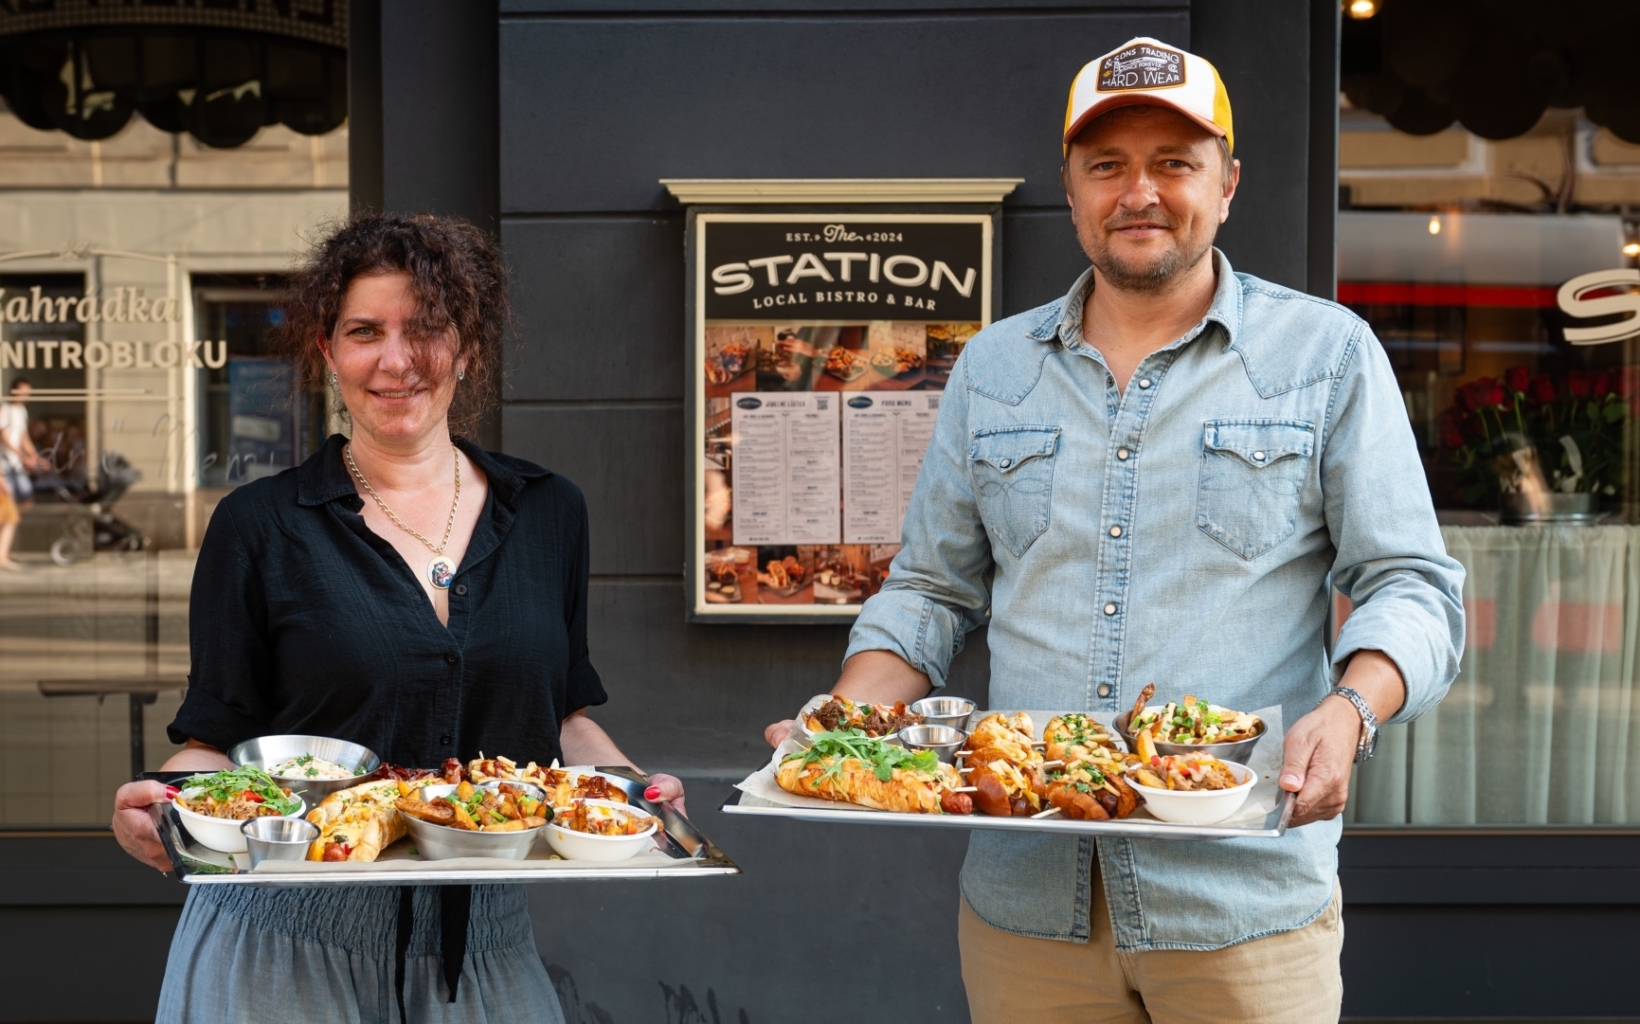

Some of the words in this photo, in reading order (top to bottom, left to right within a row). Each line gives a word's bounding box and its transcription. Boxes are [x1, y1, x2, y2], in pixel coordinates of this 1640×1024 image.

[1140, 47, 1180, 64] TRADING
[1102, 71, 1139, 87] HARD
[1143, 71, 1180, 85] WEAR
[786, 232, 814, 242] EST.
[823, 224, 864, 243] The
[872, 232, 903, 242] 2024
[711, 252, 977, 298] STATION
[0, 286, 178, 323] ahrádka
[753, 292, 808, 309] LOCAL
[816, 291, 878, 303] BISTRO
[886, 293, 896, 305] &
[905, 295, 936, 311] BAR
